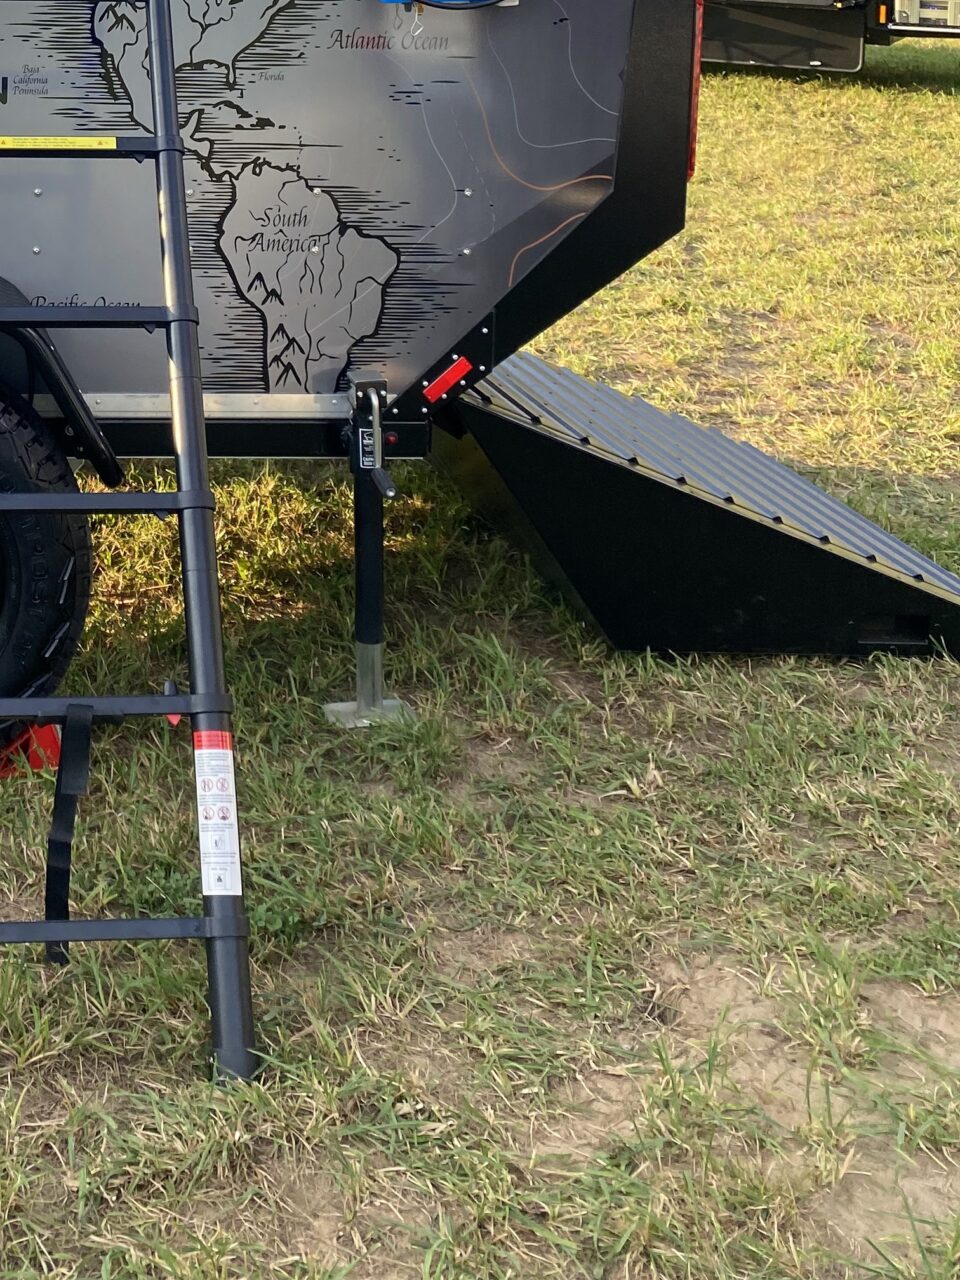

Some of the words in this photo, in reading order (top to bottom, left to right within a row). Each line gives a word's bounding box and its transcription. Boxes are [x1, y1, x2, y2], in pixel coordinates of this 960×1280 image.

[326, 26, 395, 50] Atlantic
[401, 31, 449, 50] Ocean
[13, 74, 48, 86] California
[258, 71, 286, 81] Florida
[12, 85, 49, 95] Peninsula
[261, 205, 308, 227] South
[248, 232, 319, 253] America
